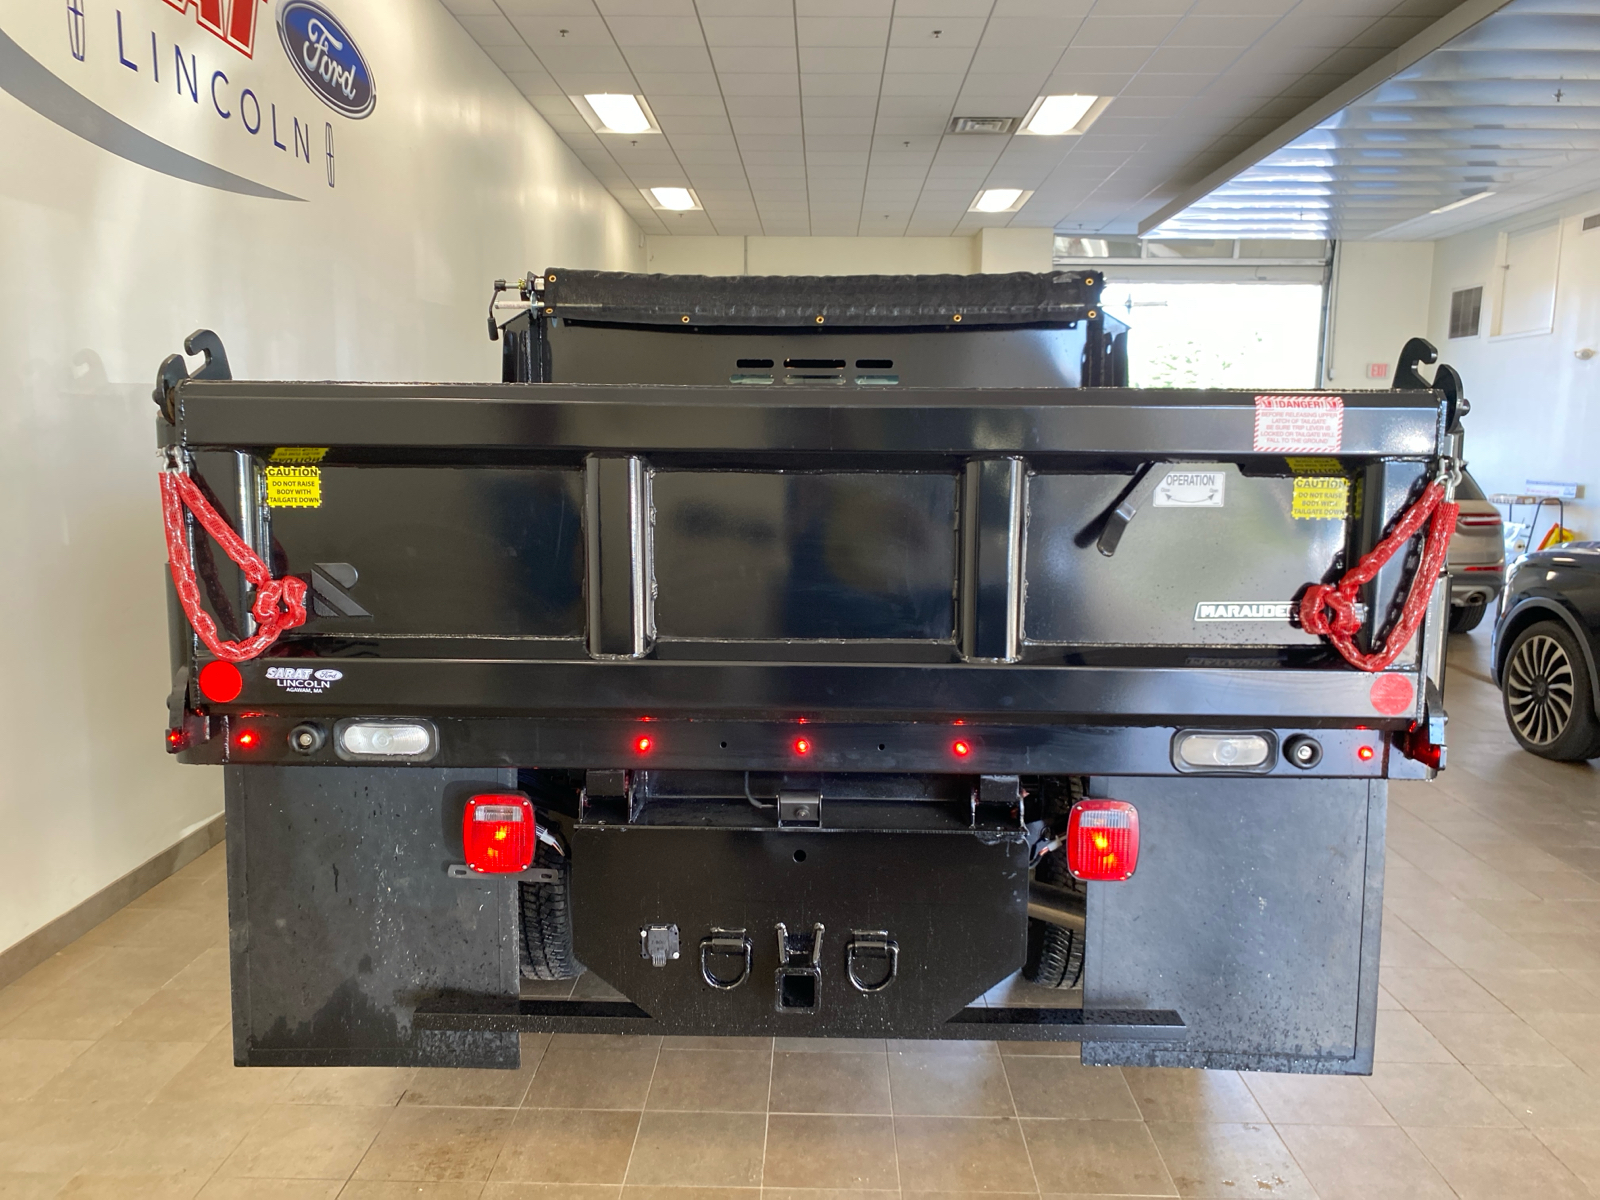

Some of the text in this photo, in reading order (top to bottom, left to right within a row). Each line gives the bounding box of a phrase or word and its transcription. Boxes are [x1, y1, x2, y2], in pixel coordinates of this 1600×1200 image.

[303, 18, 357, 100] Ford
[116, 9, 310, 164] LINCOLN
[1371, 363, 1388, 377] EXIT
[267, 468, 318, 476] CAUTION
[1166, 474, 1215, 486] OPERATION
[1295, 479, 1347, 488] CAUTION
[265, 666, 314, 680] SARAT
[276, 679, 331, 688] LINCOLN
